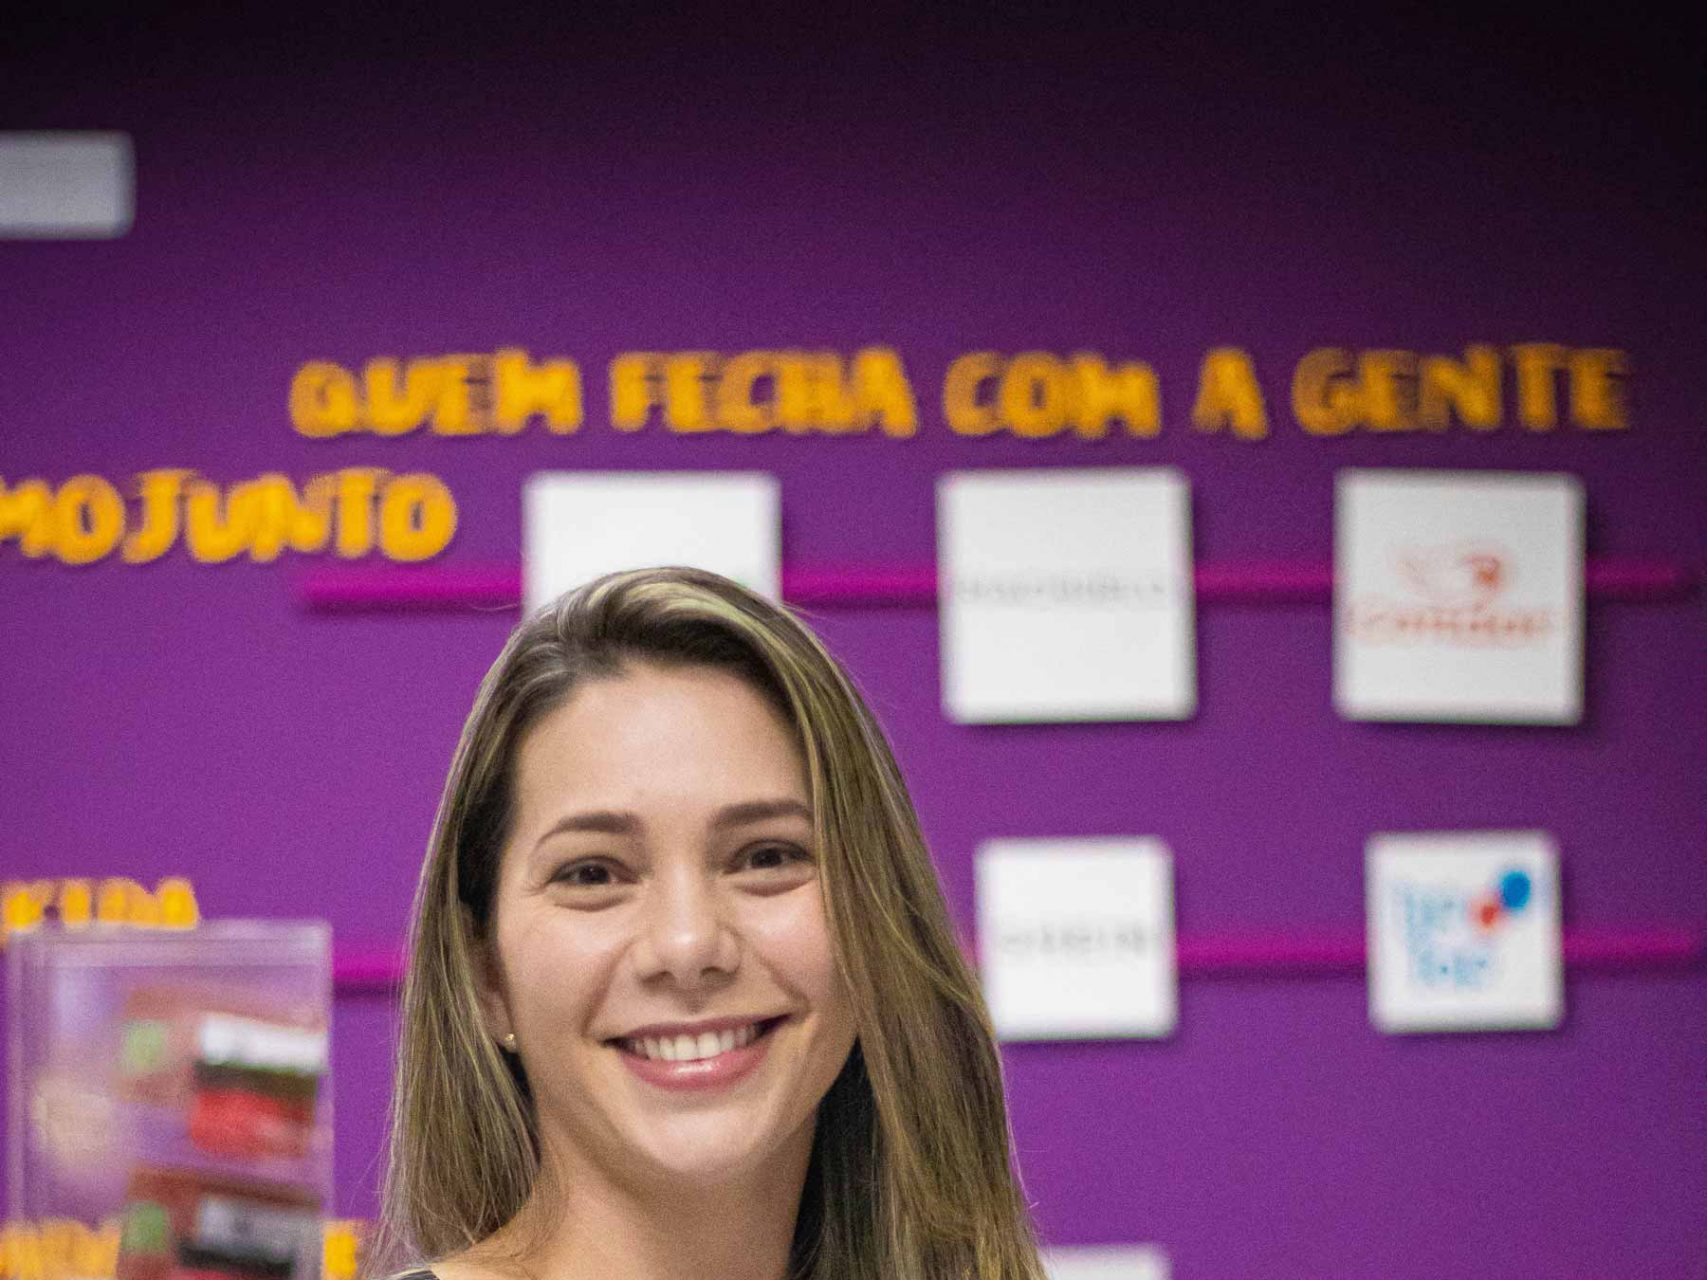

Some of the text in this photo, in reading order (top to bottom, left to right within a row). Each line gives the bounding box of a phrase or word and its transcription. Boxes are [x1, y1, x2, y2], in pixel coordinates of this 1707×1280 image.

[289, 342, 1630, 439] QUEM FECHA COM A GENTE
